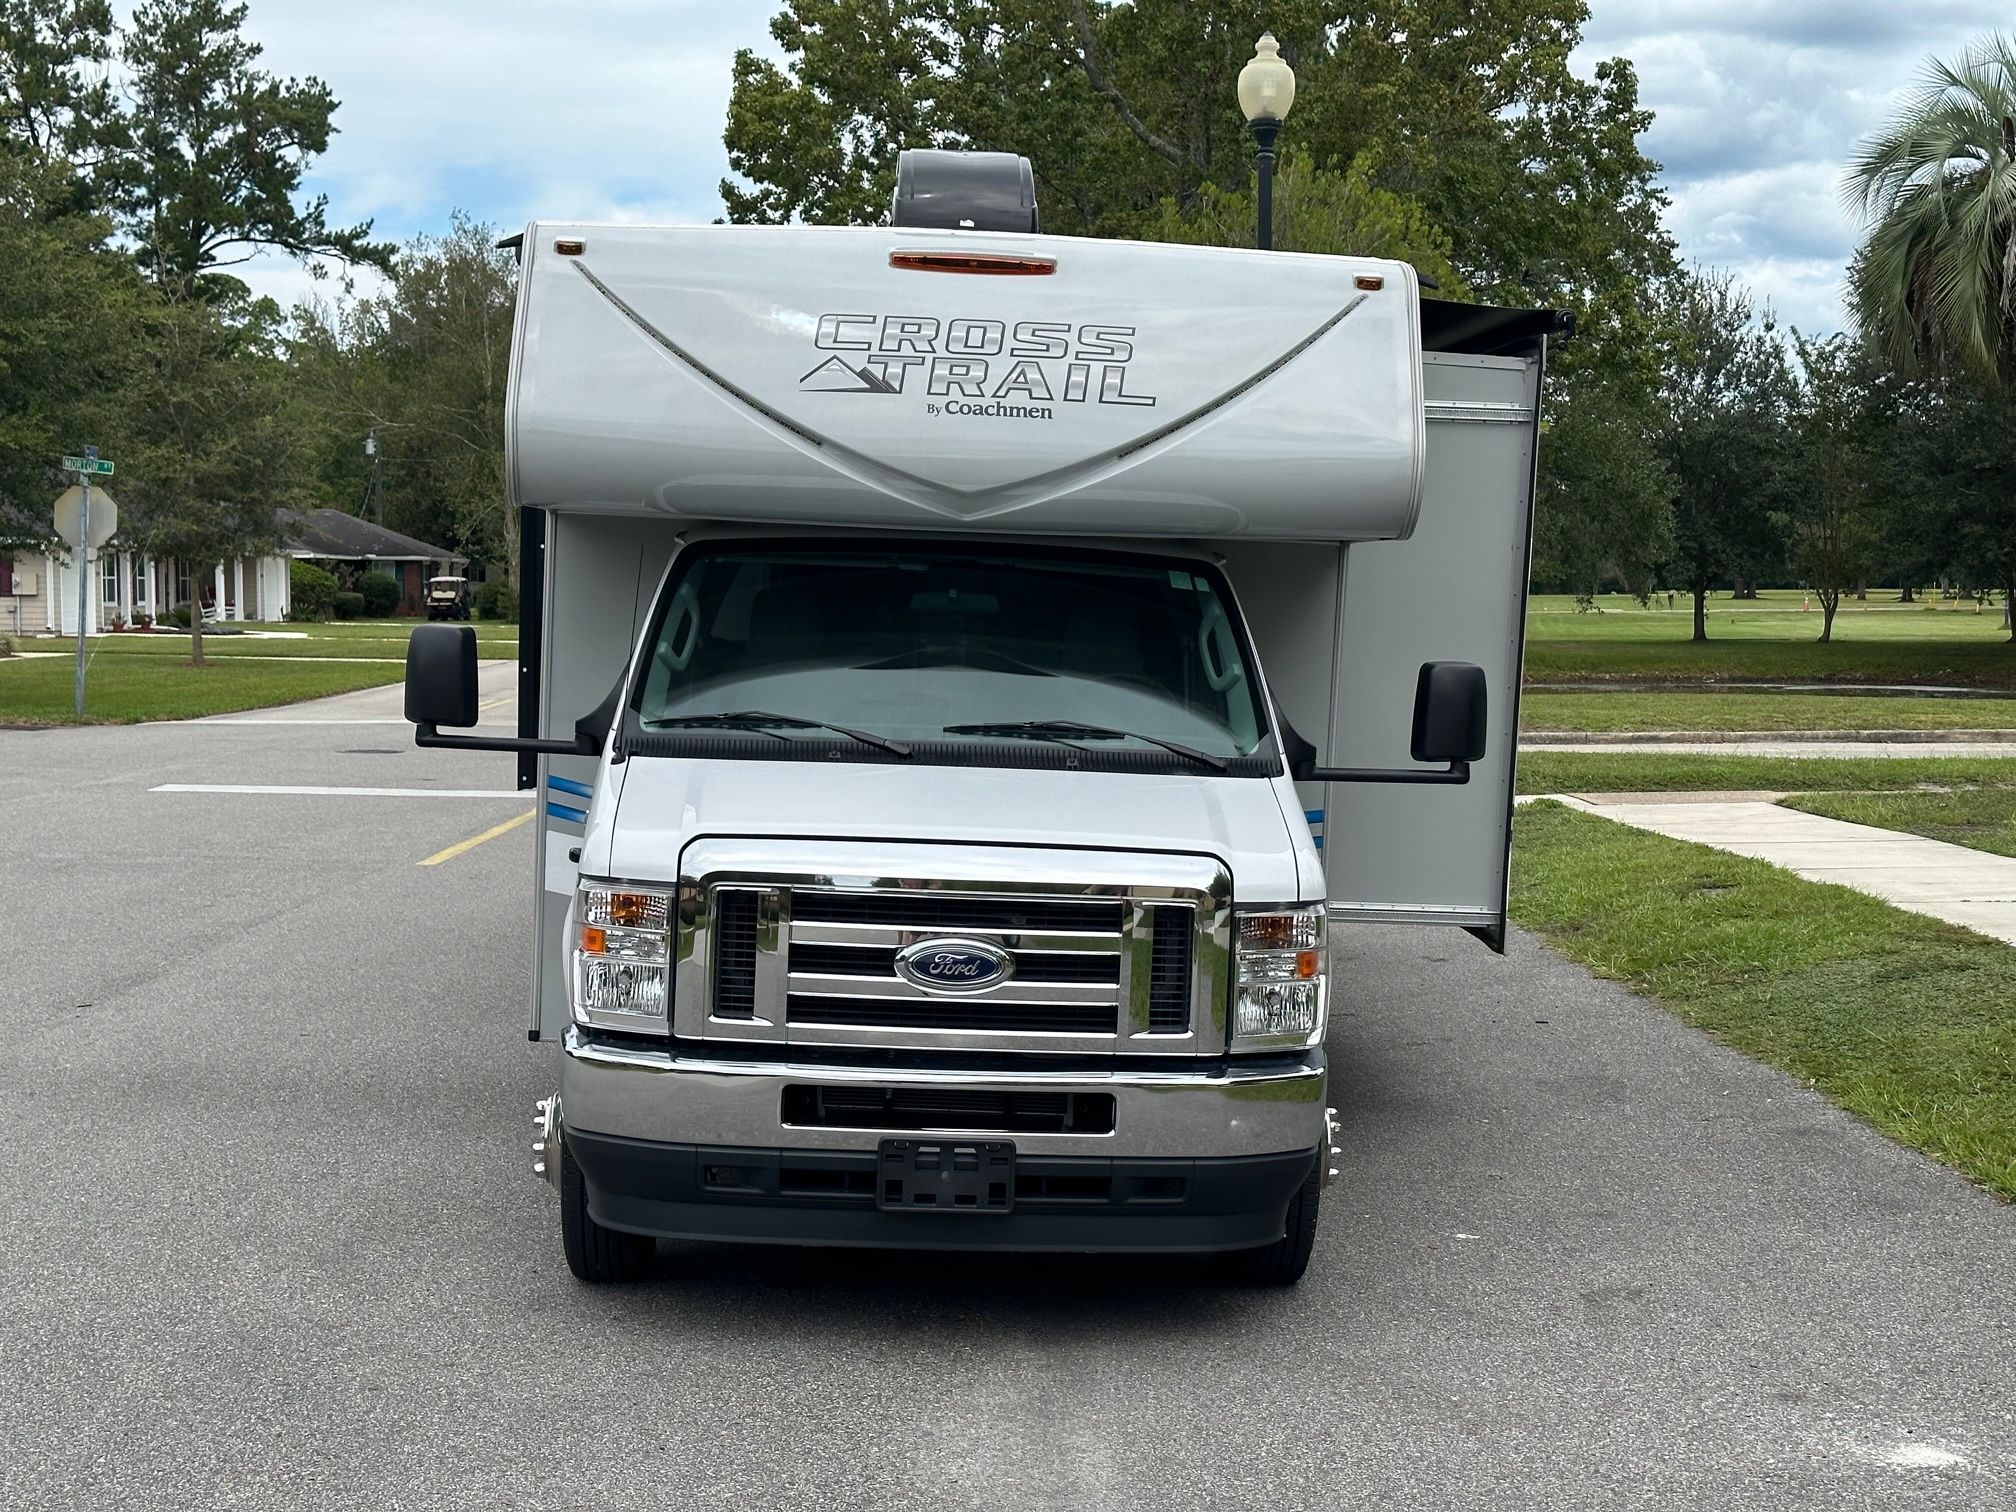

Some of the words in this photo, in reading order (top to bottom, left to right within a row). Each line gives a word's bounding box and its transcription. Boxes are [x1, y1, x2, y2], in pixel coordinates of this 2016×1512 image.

[814, 313, 1136, 362] CROSS
[867, 355, 1156, 406] TRAIL
[927, 403, 942, 418] By
[944, 400, 1053, 420] Coachmen
[65, 458, 98, 471] MORTON
[929, 953, 980, 975] Ford
